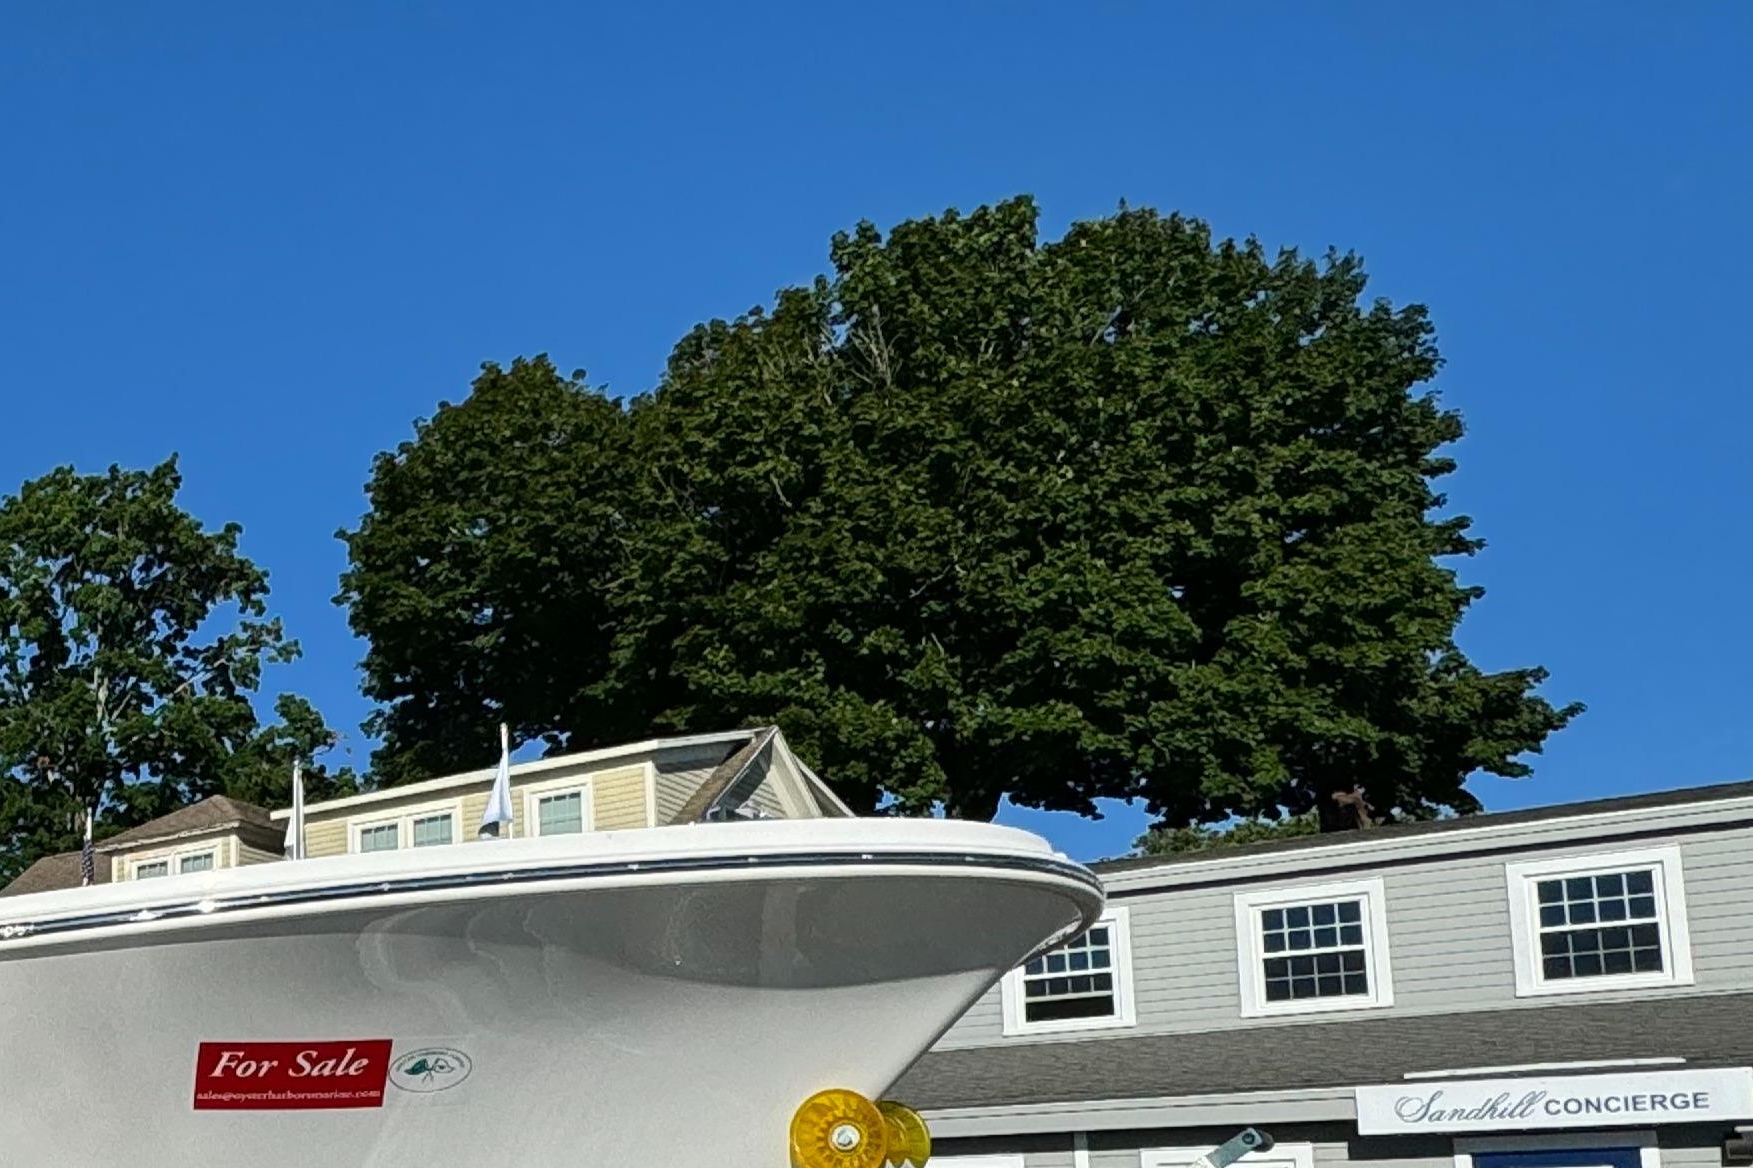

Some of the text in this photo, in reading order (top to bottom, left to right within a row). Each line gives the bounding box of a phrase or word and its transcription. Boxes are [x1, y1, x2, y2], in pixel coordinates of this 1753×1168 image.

[209, 1051, 278, 1078] For
[288, 1048, 369, 1078] Sale
[1395, 1090, 1710, 1123] Sandhill CONCIERGE
